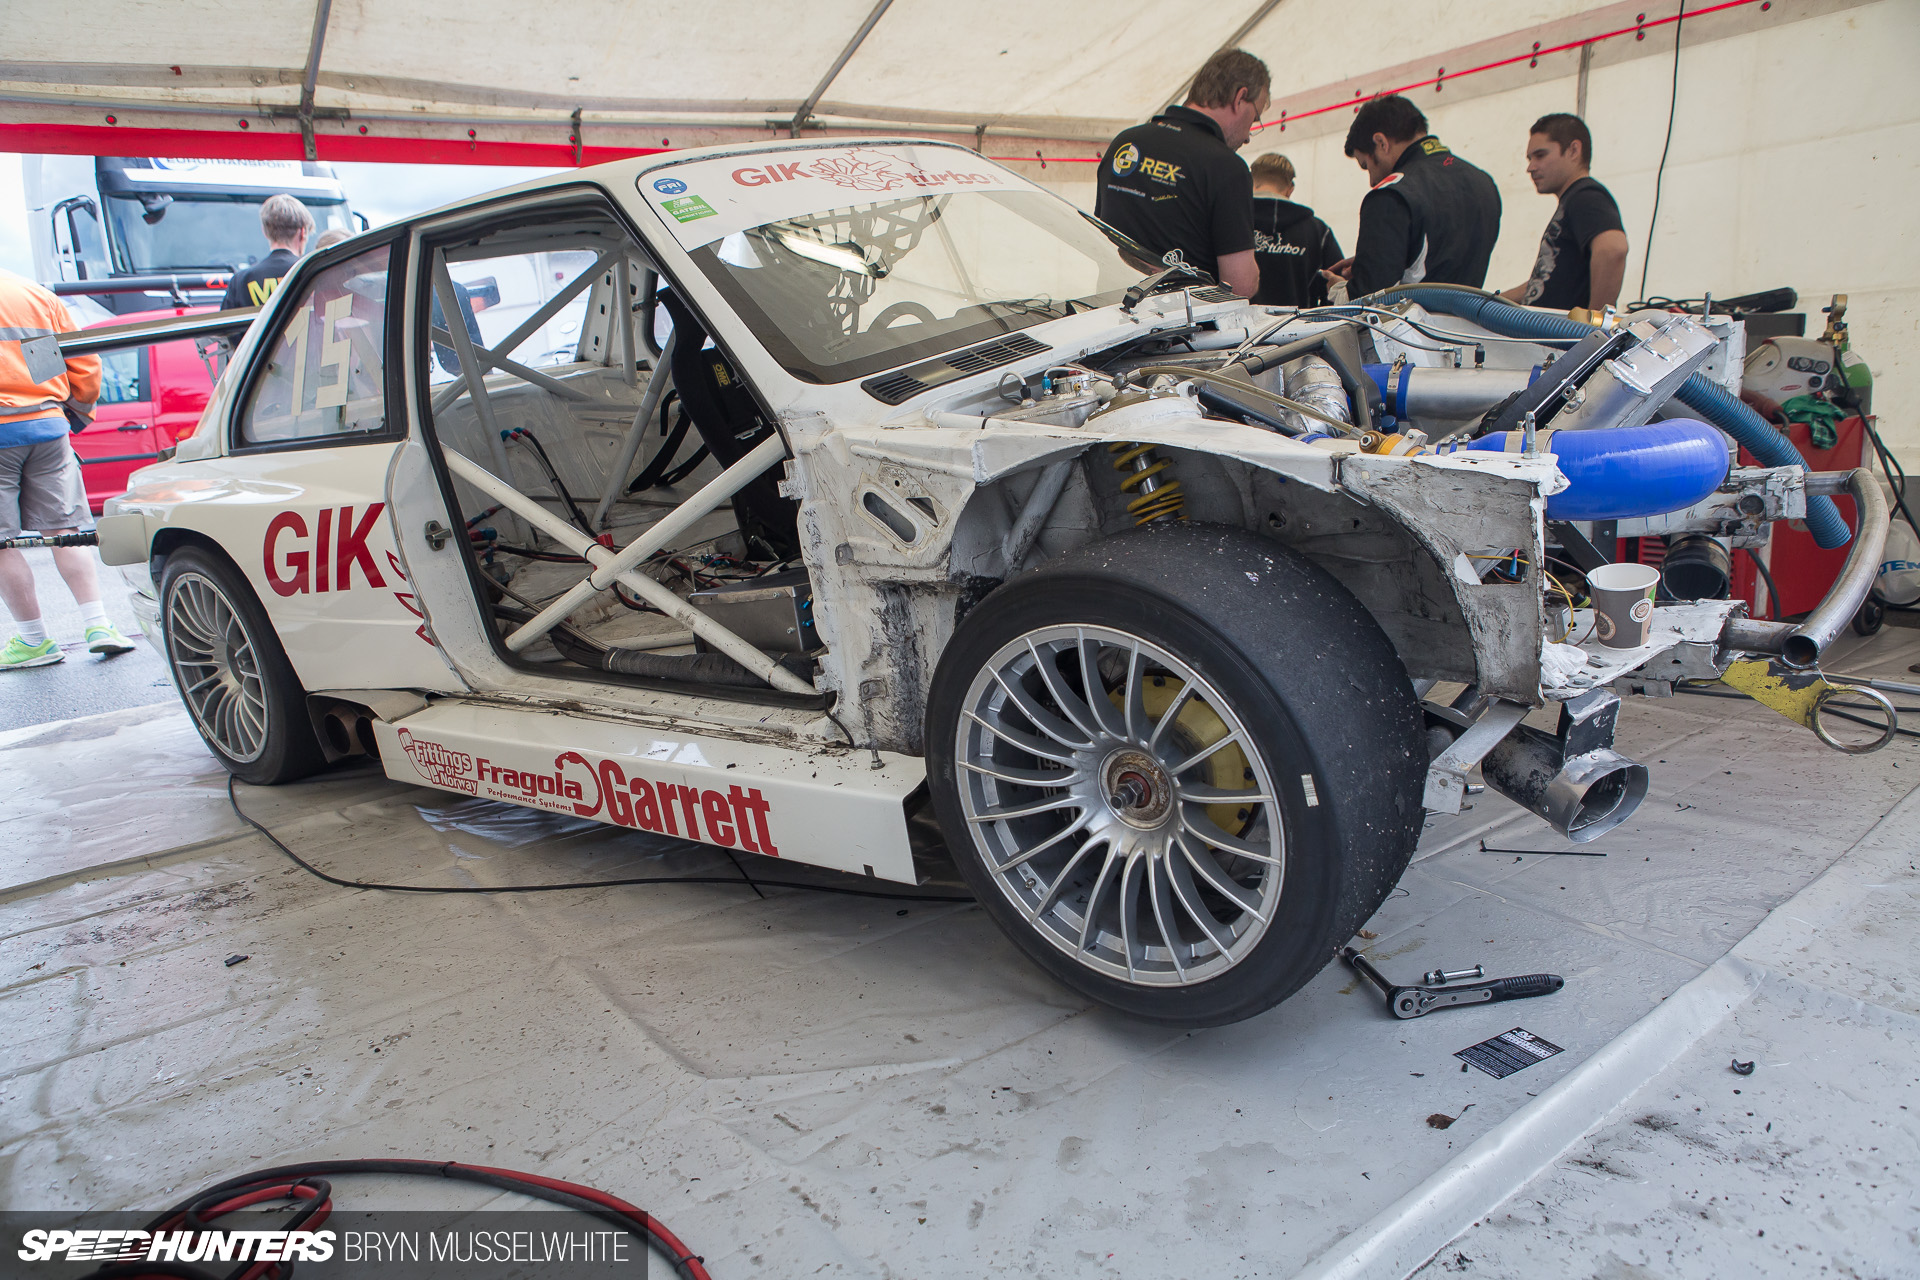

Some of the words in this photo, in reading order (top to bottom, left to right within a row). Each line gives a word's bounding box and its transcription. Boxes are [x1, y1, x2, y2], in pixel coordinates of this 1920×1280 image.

[658, 181, 681, 191] FRI
[731, 162, 812, 187] GIK
[904, 170, 990, 187] turbo
[672, 204, 707, 215] GATEBIL
[284, 293, 353, 416] 15
[714, 363, 730, 387] OMP
[263, 502, 388, 597] GIK
[414, 740, 471, 774] Fittings
[440, 771, 477, 794] Norway
[476, 758, 583, 801] Fragola
[487, 787, 537, 805] Performance
[538, 797, 572, 811] Systems
[599, 759, 779, 858] Garrett
